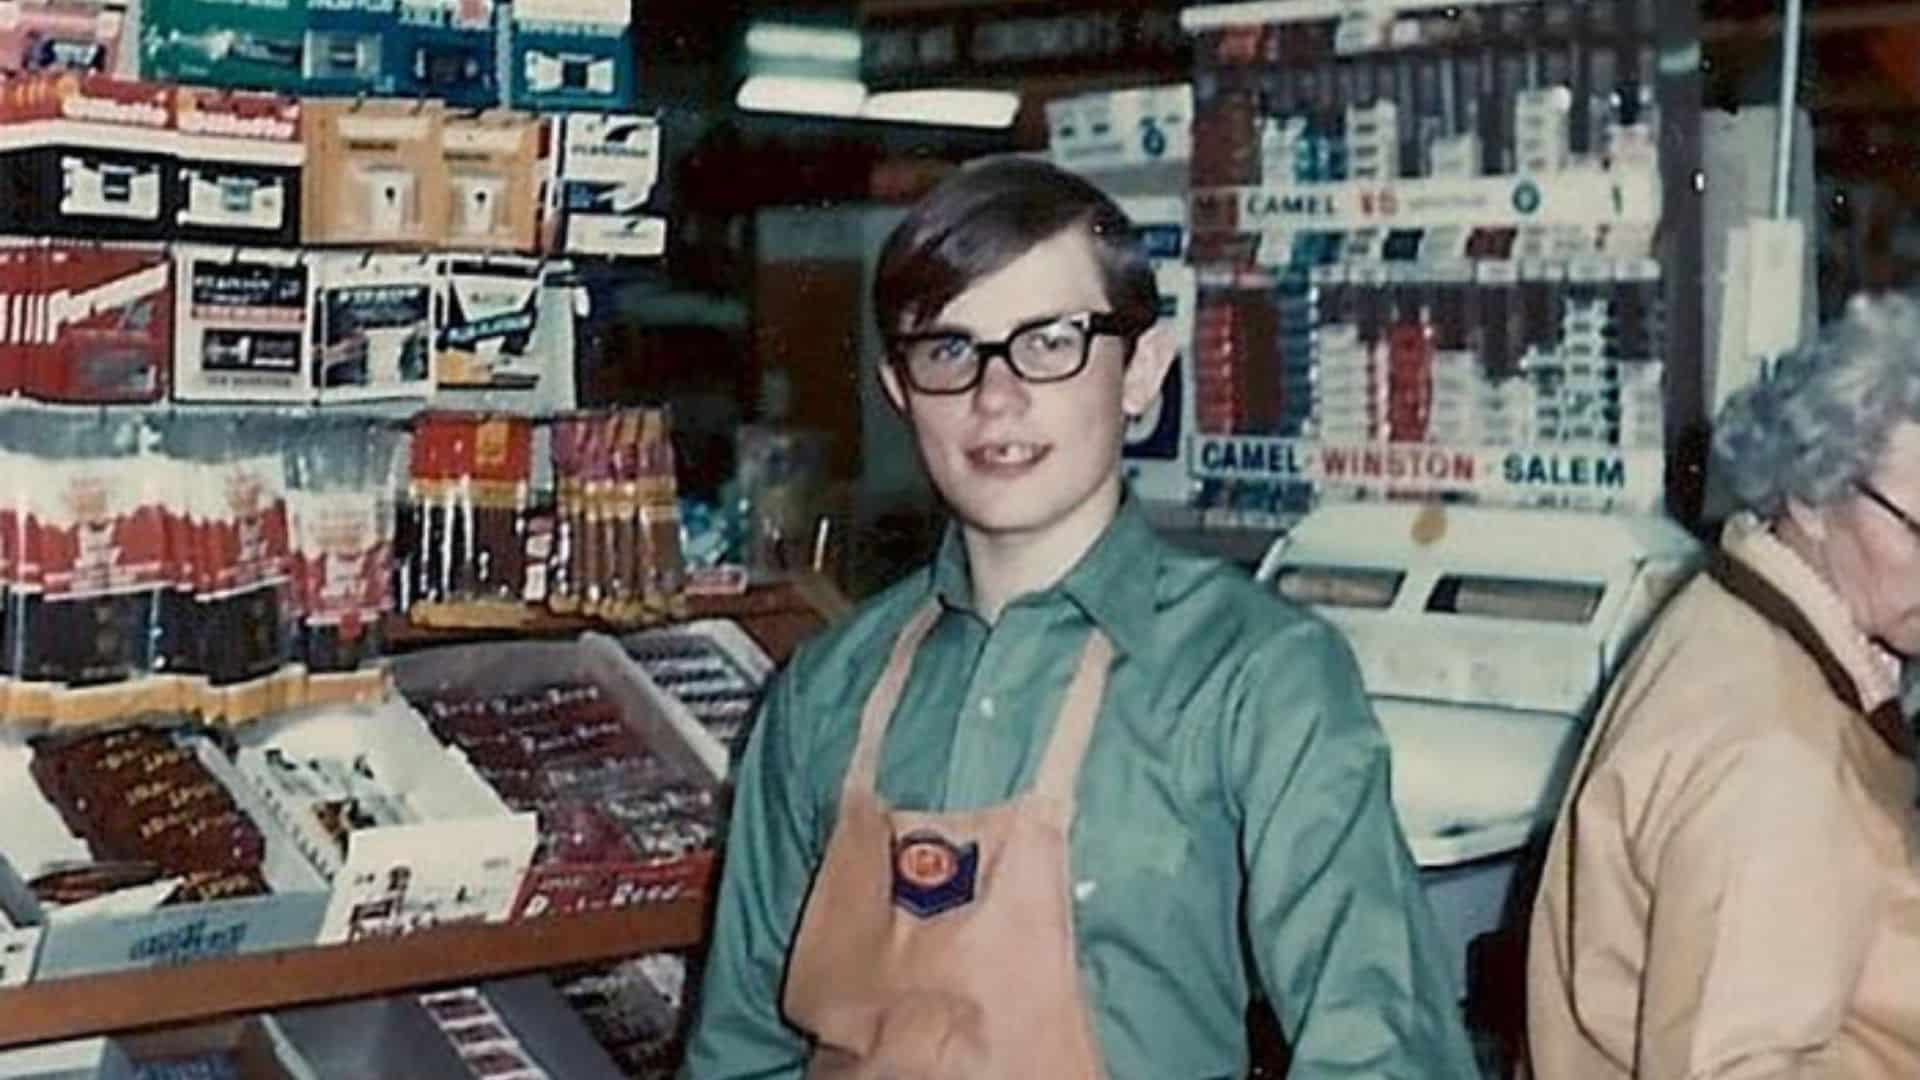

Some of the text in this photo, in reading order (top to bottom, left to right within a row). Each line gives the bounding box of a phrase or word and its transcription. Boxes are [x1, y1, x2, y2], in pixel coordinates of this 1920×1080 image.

[1247, 193, 1339, 216] CAMEL
[1201, 442, 1626, 487] CAMEL WINSTON SALEM
